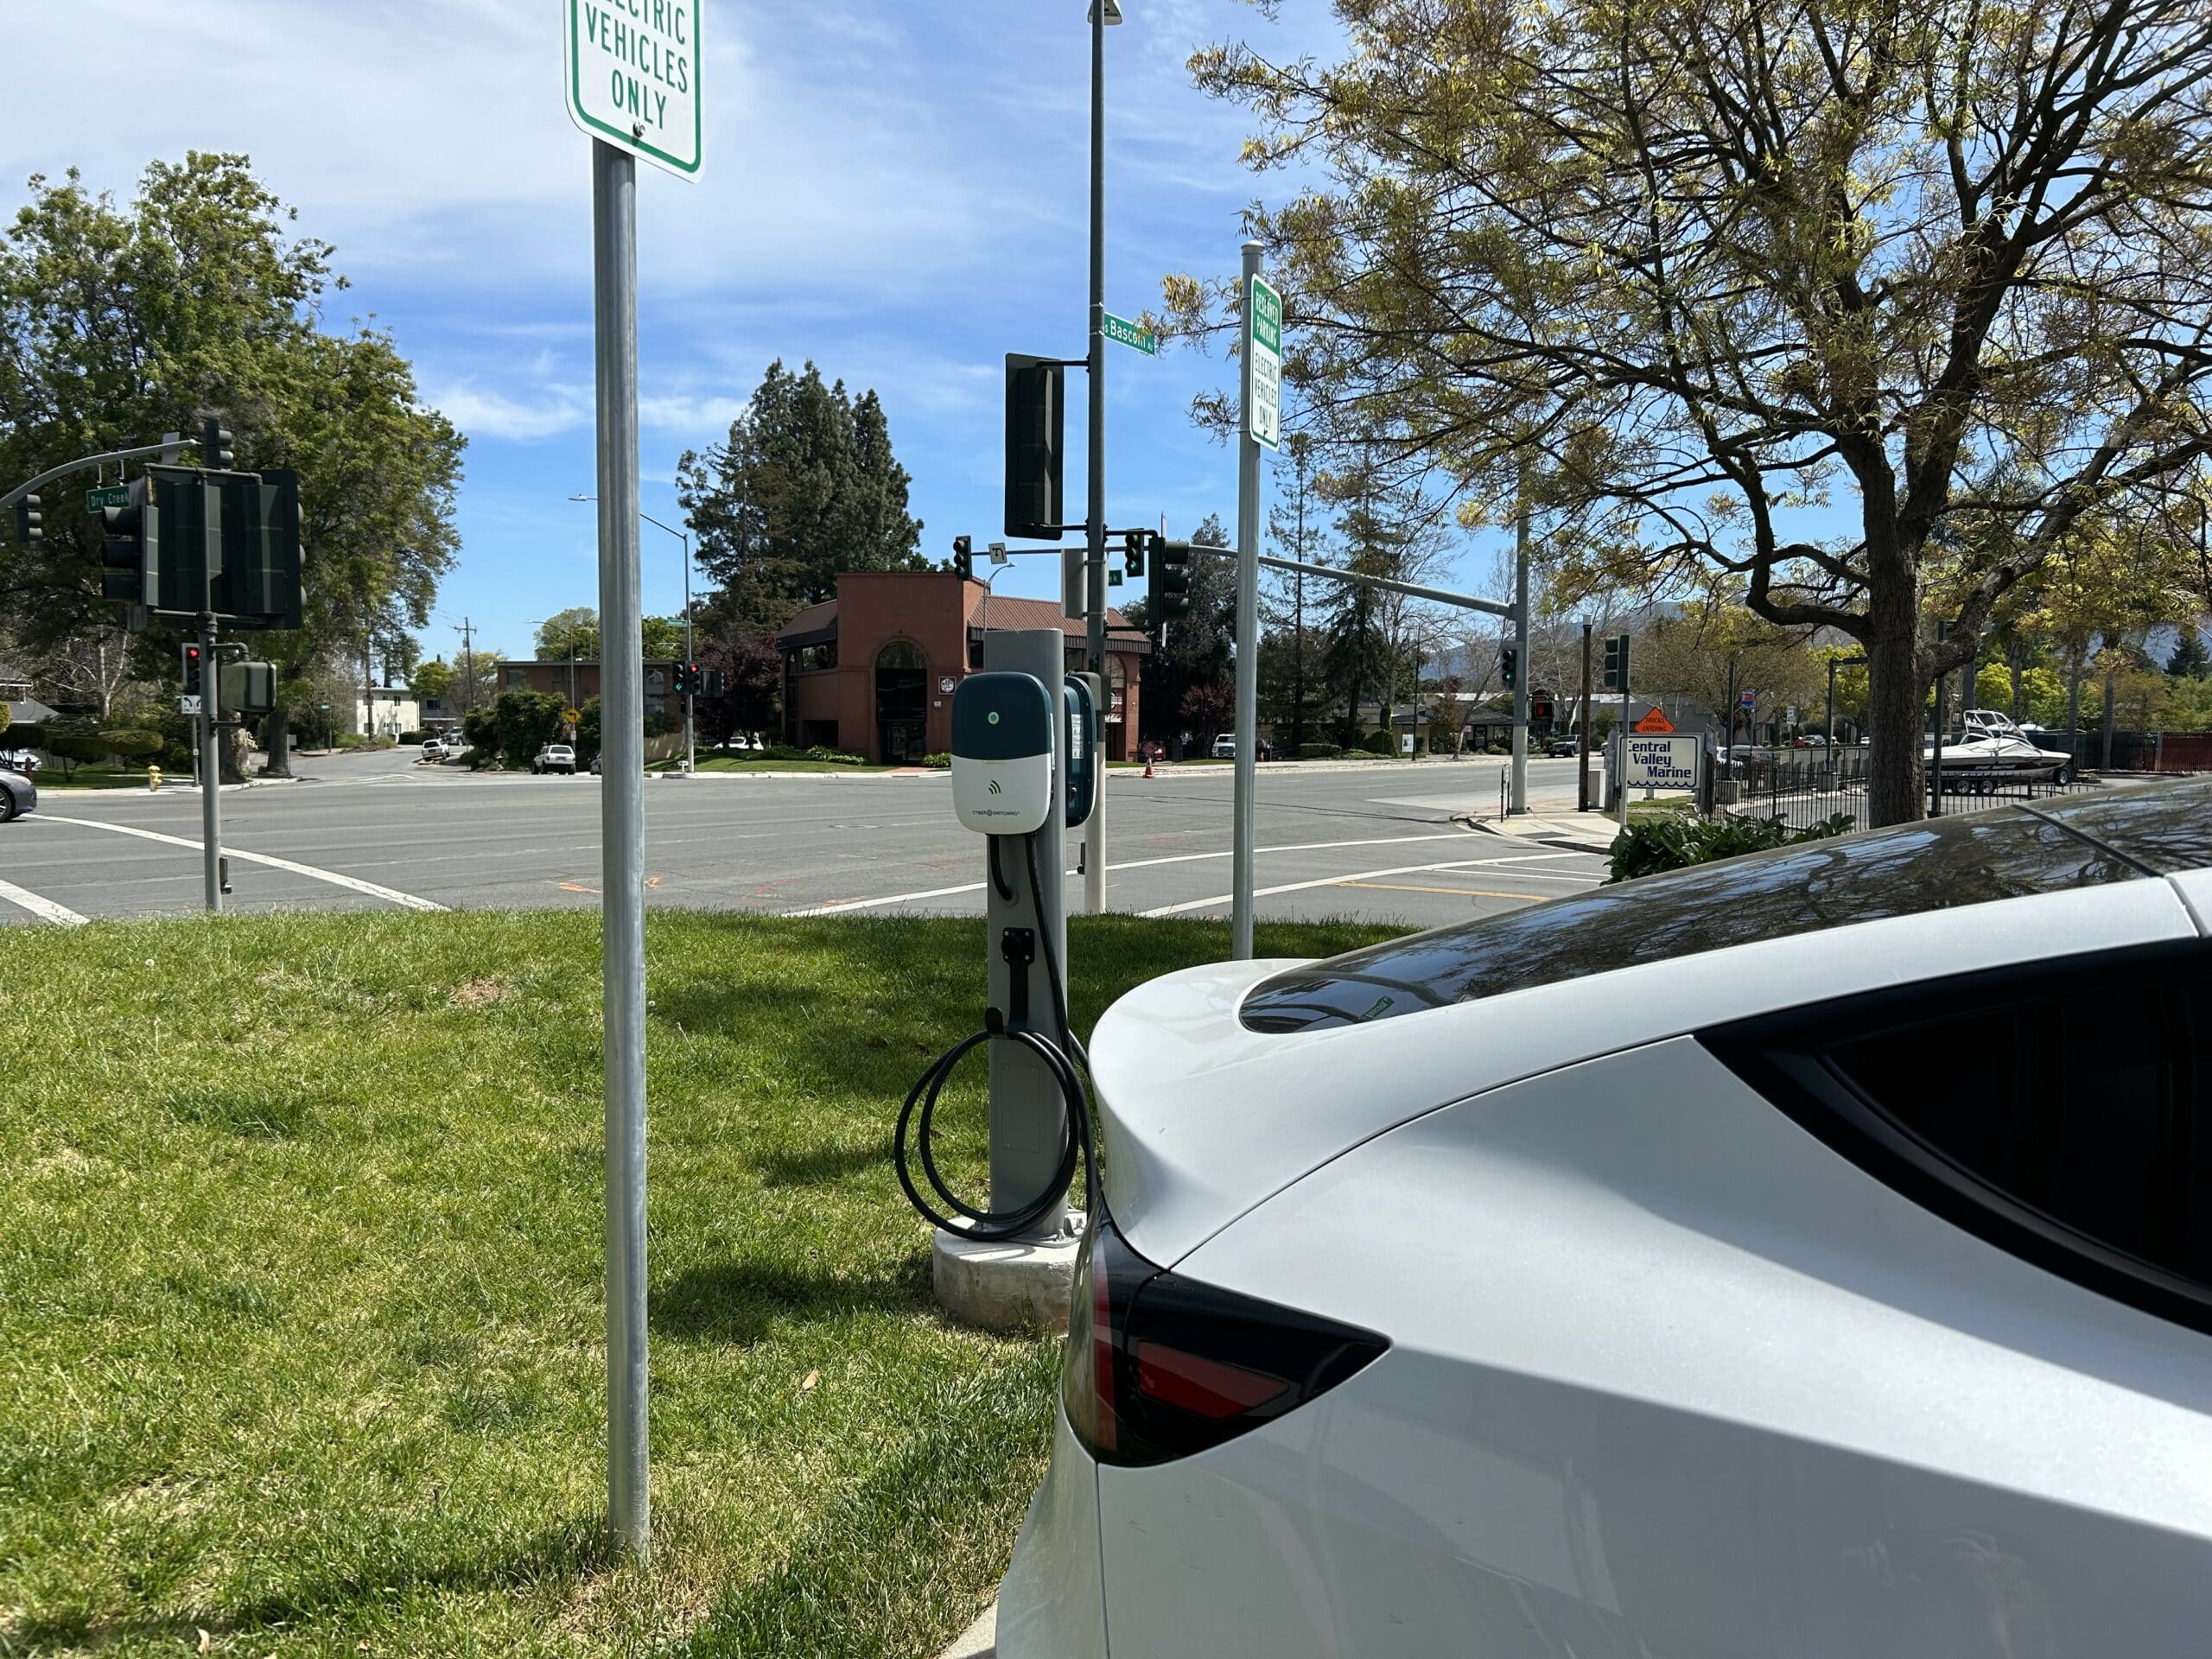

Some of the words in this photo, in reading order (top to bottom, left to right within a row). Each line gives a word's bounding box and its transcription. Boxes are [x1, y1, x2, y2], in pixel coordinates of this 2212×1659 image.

[585, 2, 688, 93] VEHICLES
[612, 69, 667, 130] ONLY
[1255, 290, 1279, 326] RESERVED
[1110, 320, 1146, 348] Bascom
[1256, 315, 1277, 347] PARKING
[1255, 352, 1277, 385] ELECTRIC
[1255, 376, 1277, 409] VEHICLES
[1259, 405, 1272, 429] ONLY
[91, 495, 104, 508] Dry
[1633, 753, 1672, 767] Valley
[1647, 766, 1692, 779] Marine
